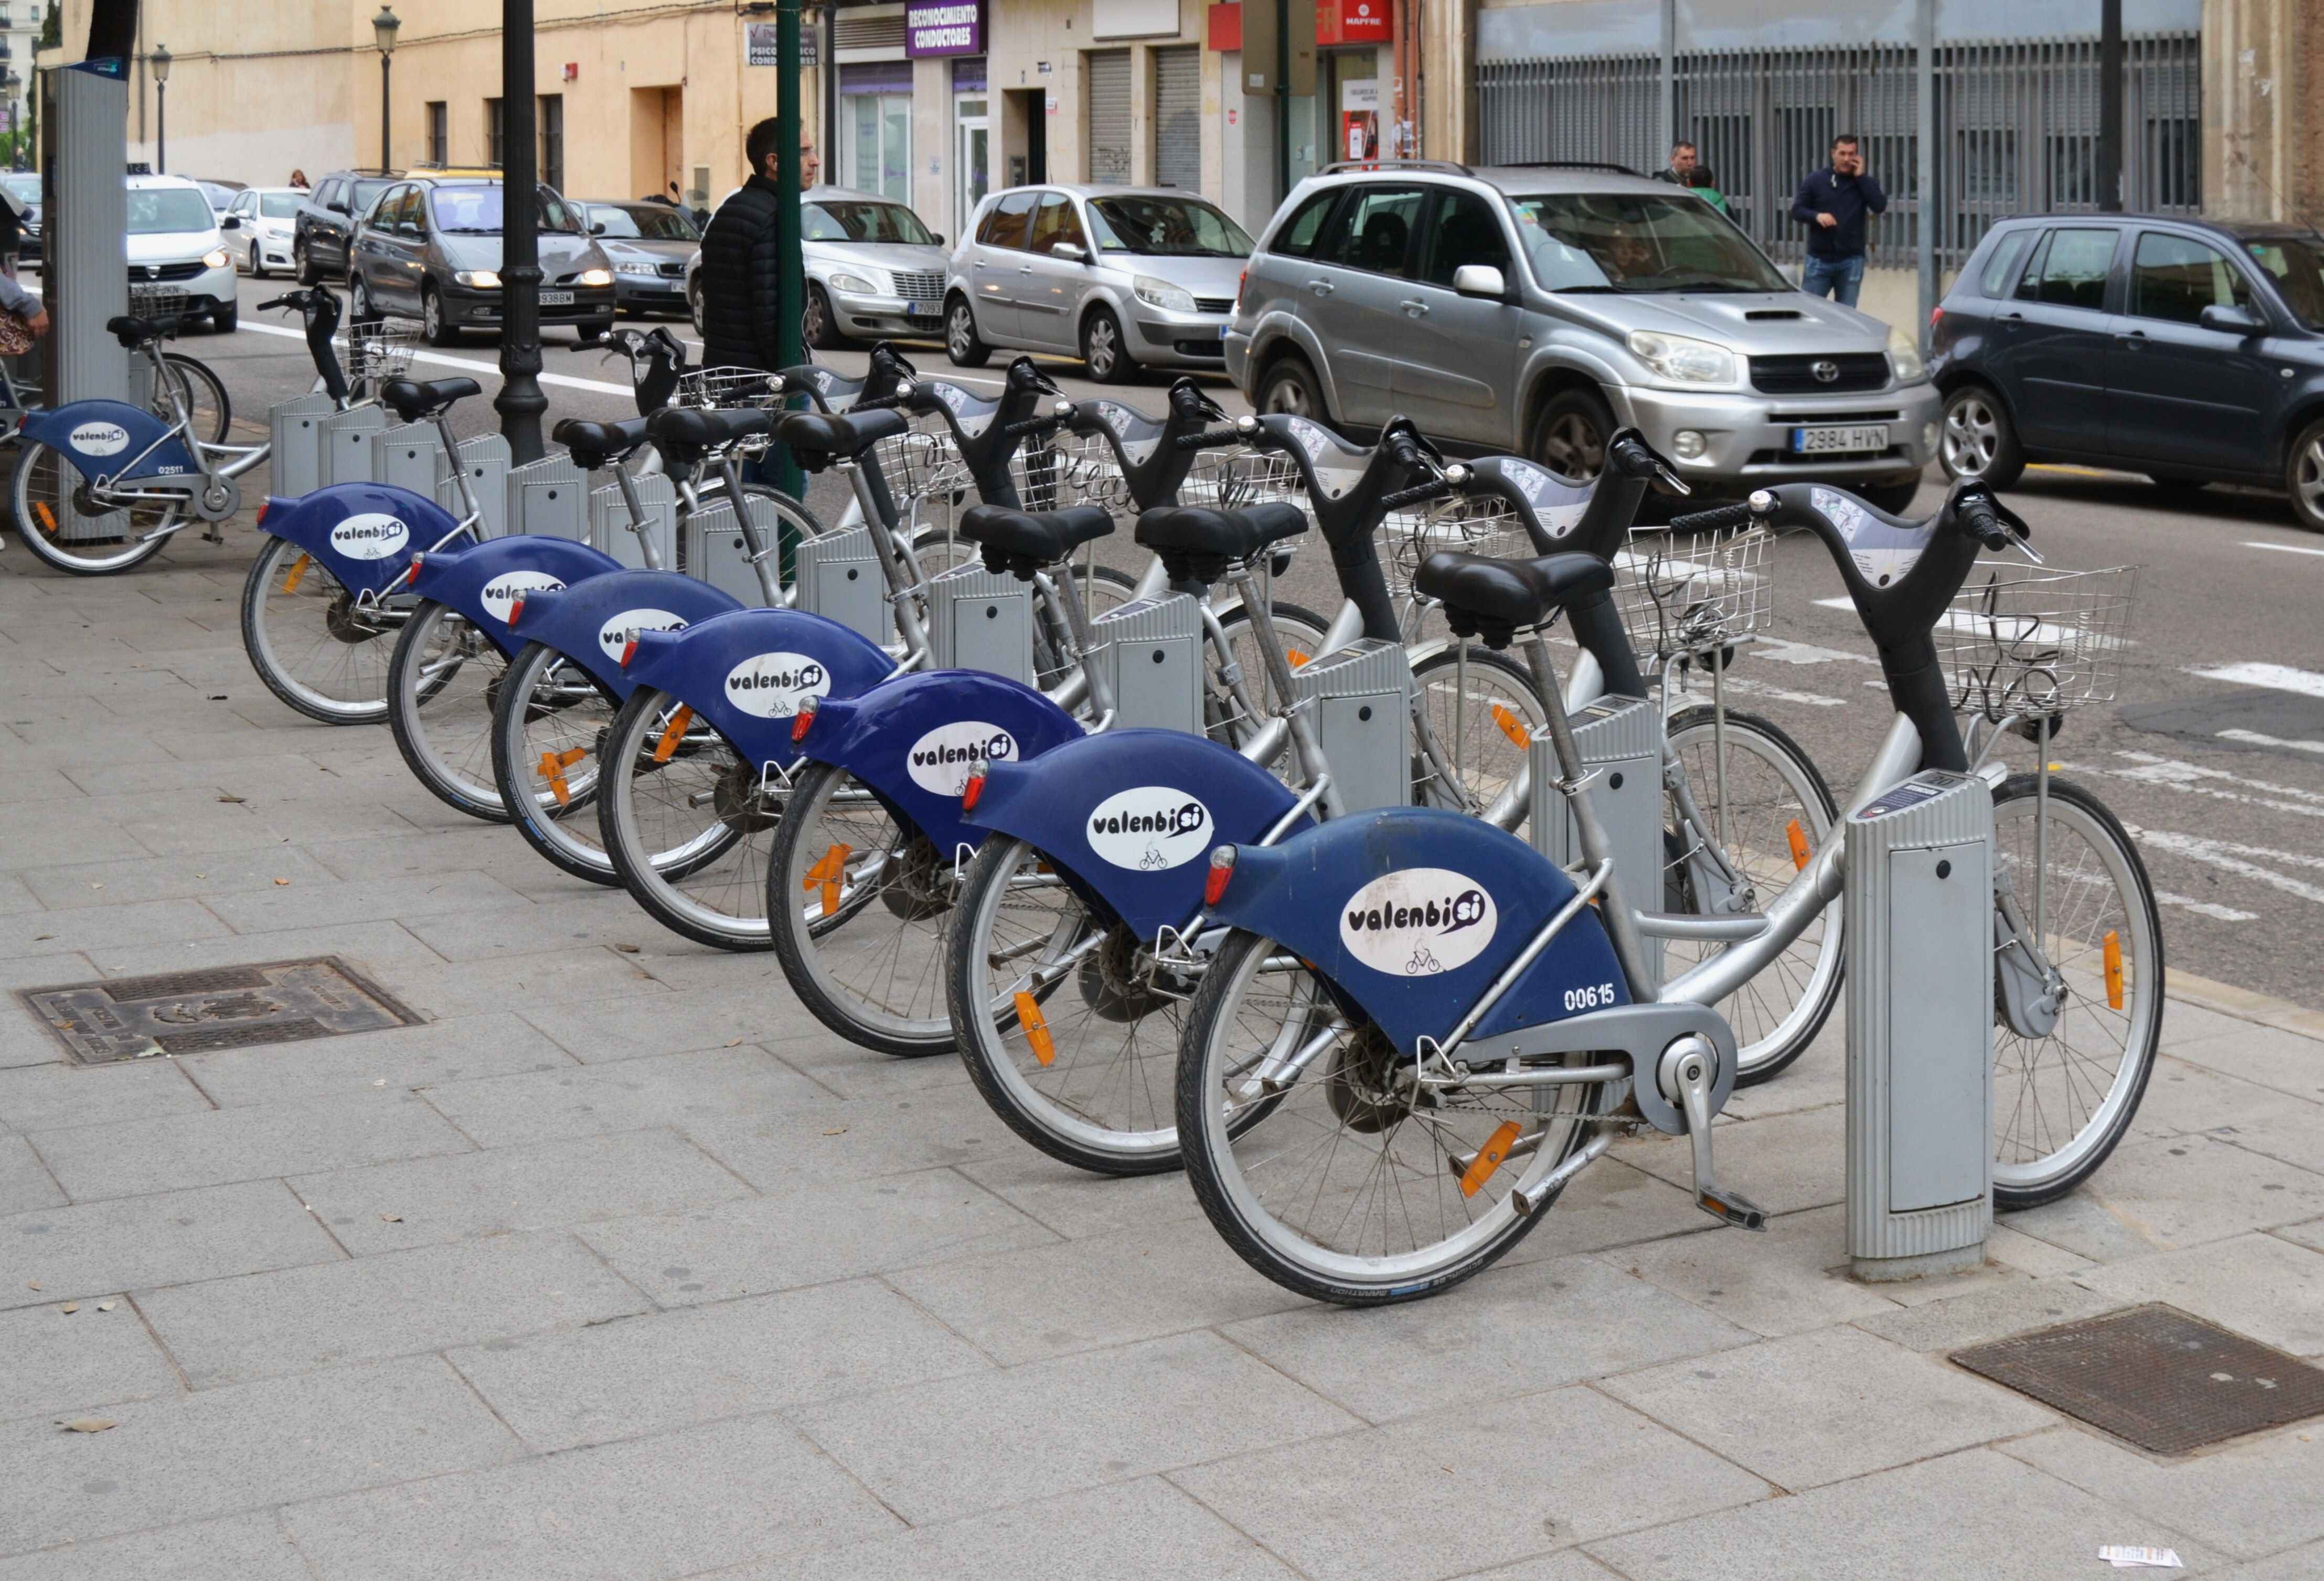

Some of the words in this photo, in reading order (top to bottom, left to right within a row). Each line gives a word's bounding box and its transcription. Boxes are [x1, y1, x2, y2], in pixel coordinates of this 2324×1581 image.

[909, 4, 977, 28] RECONOCIMIENTO
[915, 26, 971, 49] CONDUCTORES
[1806, 430, 1847, 450] 2984
[1852, 429, 1884, 446] HVN
[158, 465, 183, 474] 02511
[335, 521, 402, 540] valenbisi
[730, 666, 822, 690] valenbisi
[913, 735, 1010, 766] valenbisi
[1093, 804, 1203, 834] valenbisi
[1348, 891, 1484, 931] valenbisi
[1564, 982, 1615, 1011] 00615
[1433, 1257, 1484, 1286] SCHWALBE
[1330, 1288, 1388, 1297] MARATHON
